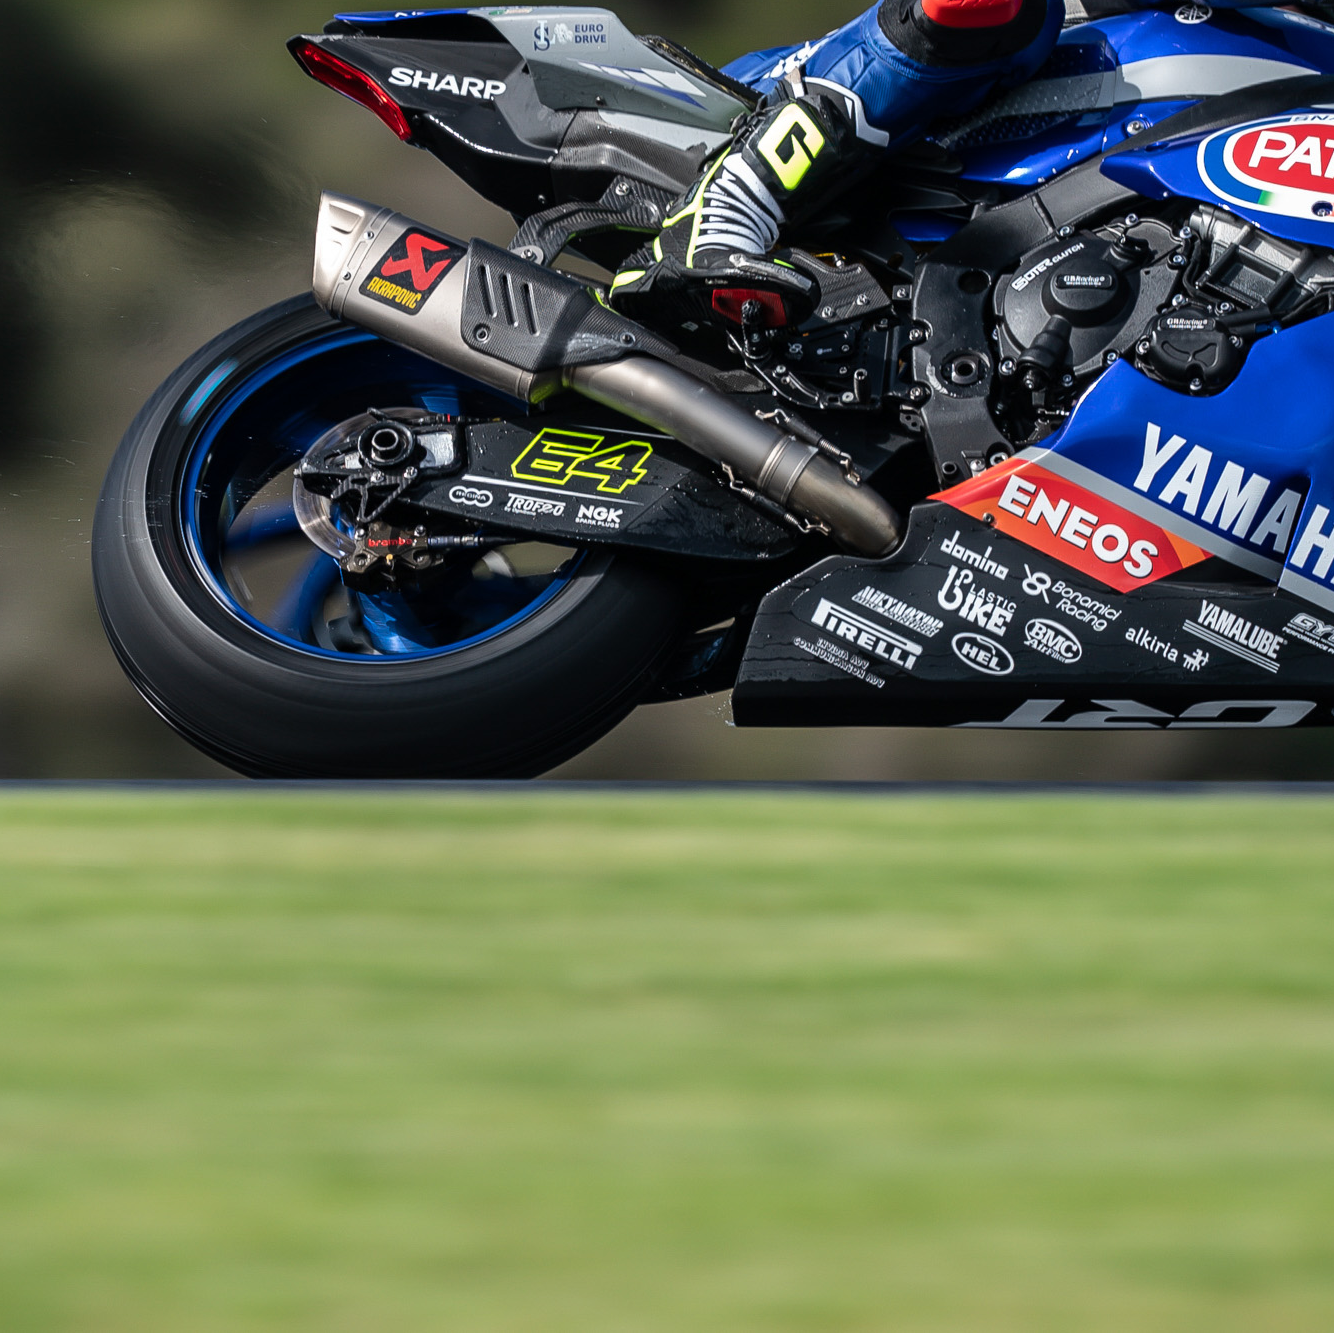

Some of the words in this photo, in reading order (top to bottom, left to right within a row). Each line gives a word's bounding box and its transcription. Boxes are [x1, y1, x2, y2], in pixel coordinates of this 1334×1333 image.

[574, 23, 604, 33] EURO
[574, 34, 607, 44] DRIVE
[388, 67, 507, 100] SHARP
[1052, 242, 1085, 264] CLUTCH
[511, 428, 653, 494] 64
[456, 490, 486, 502] REGINA
[575, 518, 597, 526] SPARK
[597, 520, 620, 528] PLUGS
[578, 504, 623, 523] NGK
[997, 474, 1158, 580] ENEOS
[368, 537, 413, 547] brembo
[940, 530, 1009, 580] domino
[1051, 580, 1122, 621] Bonamici
[1056, 598, 1108, 632] Racing
[811, 597, 923, 671] PIRELLI
[1026, 621, 1077, 659] BMC
[1125, 626, 1177, 662] alkiria
[1196, 599, 1281, 659] YAMALUBE
[1282, 626, 1328, 652] PERFORMANCE
[961, 642, 1001, 671] HEL
